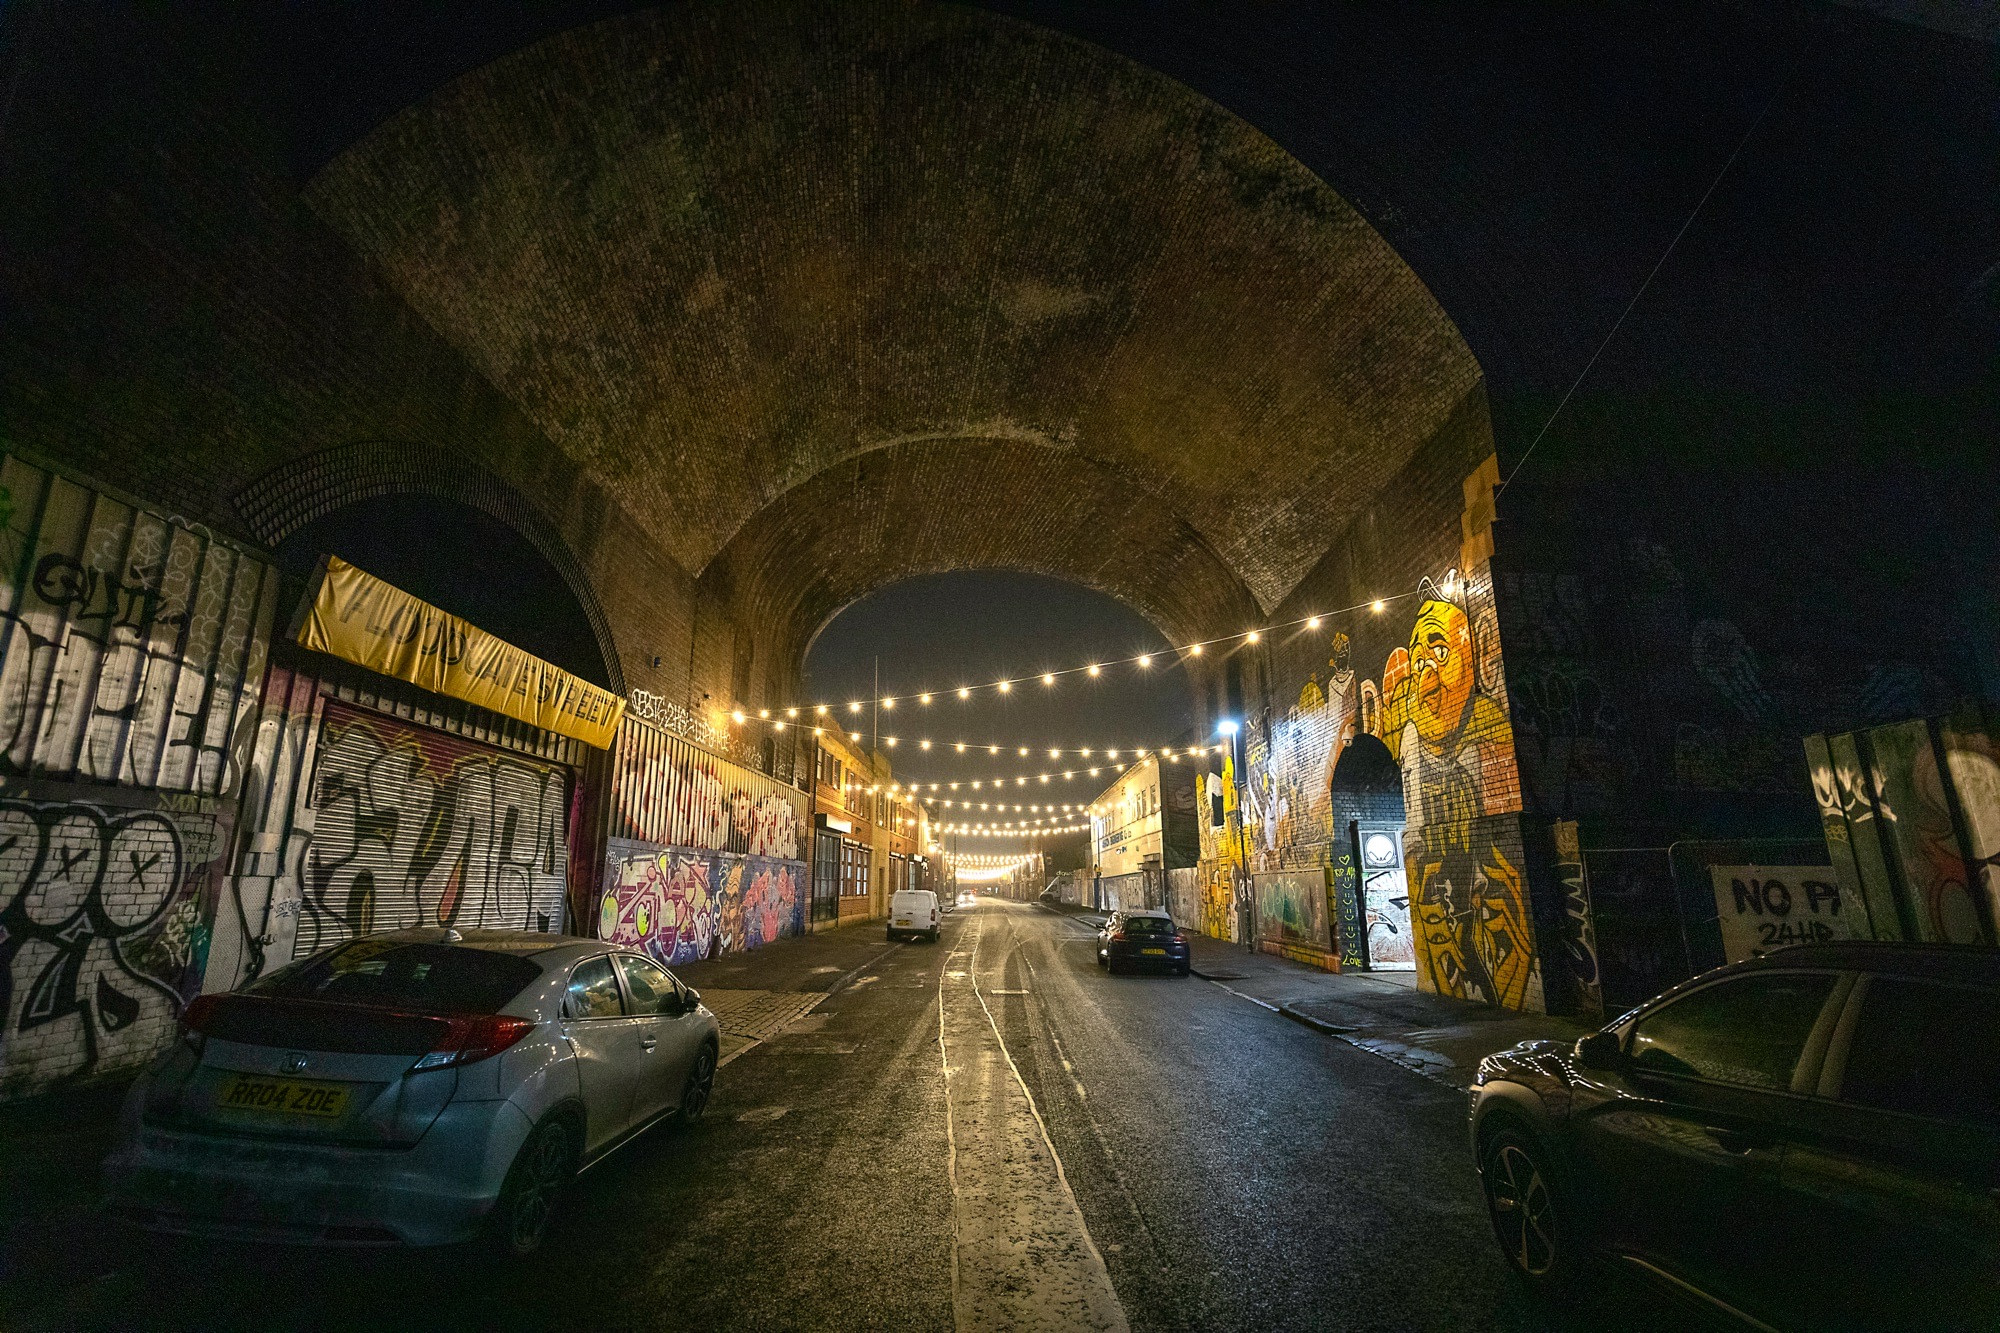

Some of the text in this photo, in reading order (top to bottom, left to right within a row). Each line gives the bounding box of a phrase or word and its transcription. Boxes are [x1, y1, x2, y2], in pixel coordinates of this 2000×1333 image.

[340, 583, 536, 696] FLOODGATE
[533, 674, 615, 726] STREET
[1731, 878, 1791, 917] NO
